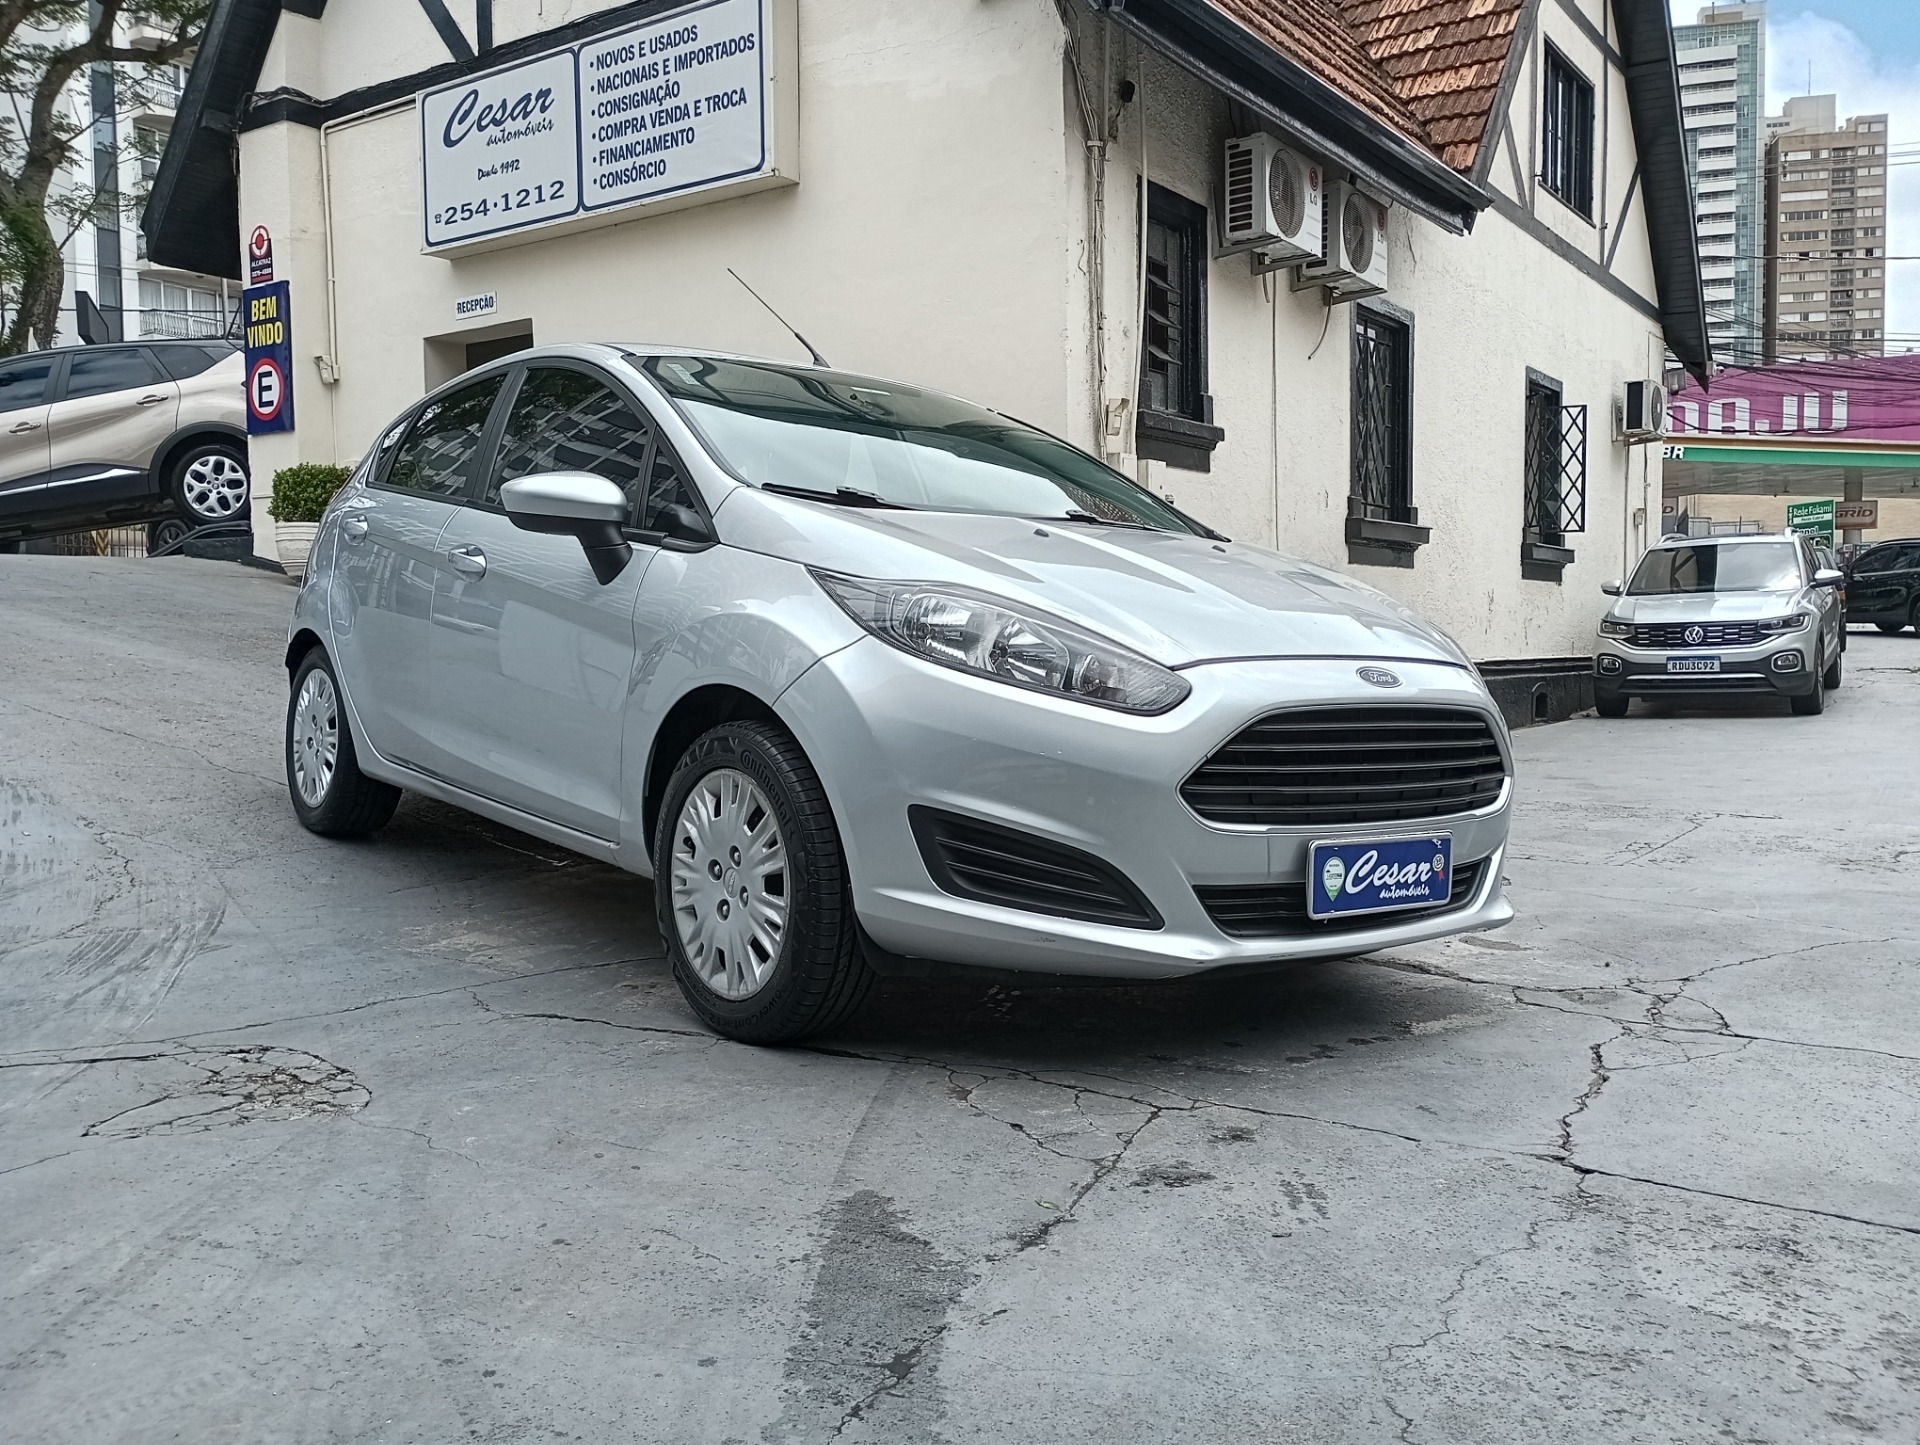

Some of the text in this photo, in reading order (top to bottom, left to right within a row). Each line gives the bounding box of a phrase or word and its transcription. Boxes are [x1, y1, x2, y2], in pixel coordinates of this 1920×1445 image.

[596, 24, 699, 71] NOVOS E USADOS
[596, 33, 756, 96] NACIONAIS E IMPORTADOS
[597, 80, 681, 120] CONSIGNAÇÃO
[598, 87, 747, 144] COMPRA VENDA E TROCA
[443, 86, 555, 148] Cesar
[486, 118, 554, 148] automóveis
[599, 126, 696, 166] FINANCIAMENTO
[499, 158, 520, 175] 1992
[599, 158, 667, 190] CONSÓRCIO
[1309, 192, 1318, 207] LG
[251, 295, 277, 322] BEM
[456, 295, 495, 315] RECEPÇÃO
[247, 321, 283, 349] VINDO
[258, 370, 274, 408] E
[1368, 671, 1394, 684] Ford
[1671, 661, 1715, 671] RDU3C92
[740, 748, 793, 828] Continental
[1345, 850, 1432, 894] Cesar
[1379, 884, 1431, 899] automóveis
